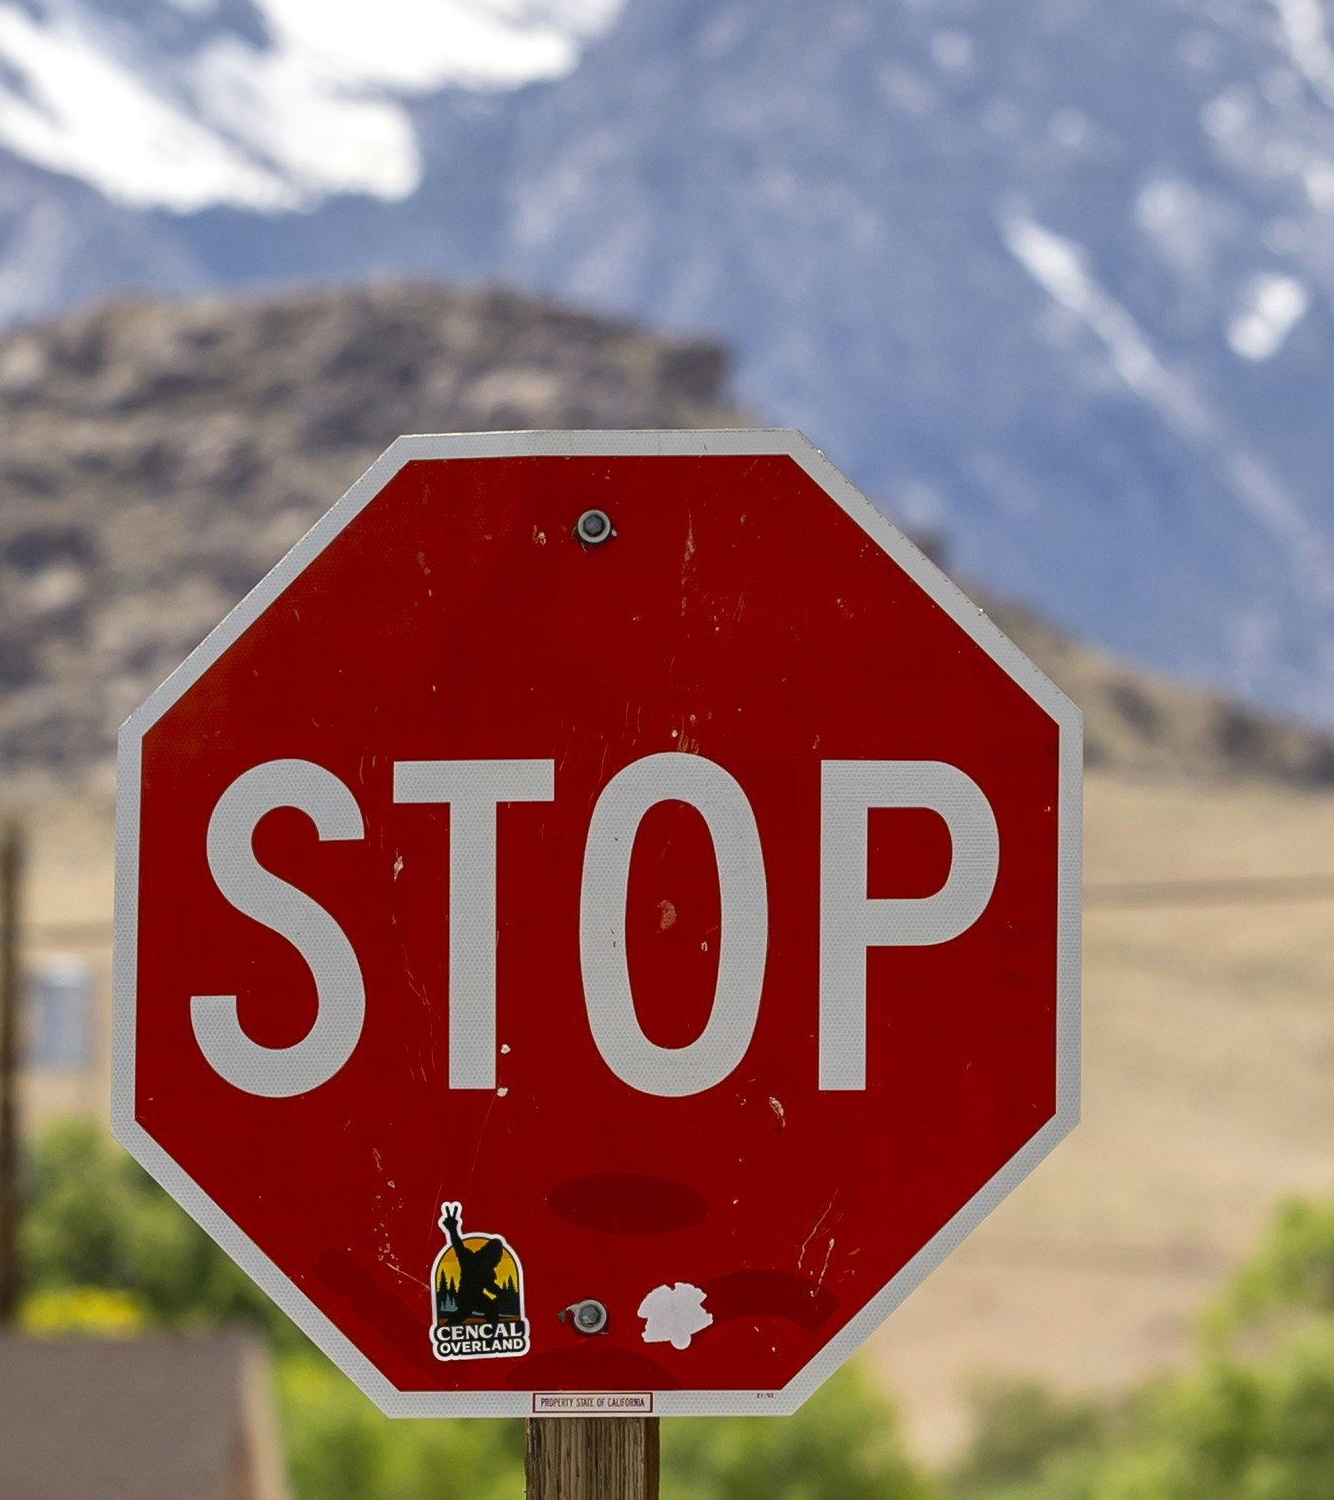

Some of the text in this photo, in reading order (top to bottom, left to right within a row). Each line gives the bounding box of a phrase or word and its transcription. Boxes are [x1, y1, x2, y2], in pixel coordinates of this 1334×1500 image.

[189, 752, 1000, 1098] STOP
[436, 1322, 523, 1341] CENCAL
[439, 1338, 524, 1354] OVERLAND
[540, 1397, 645, 1408] PROPERTY STATE OF CALIFORNIA
